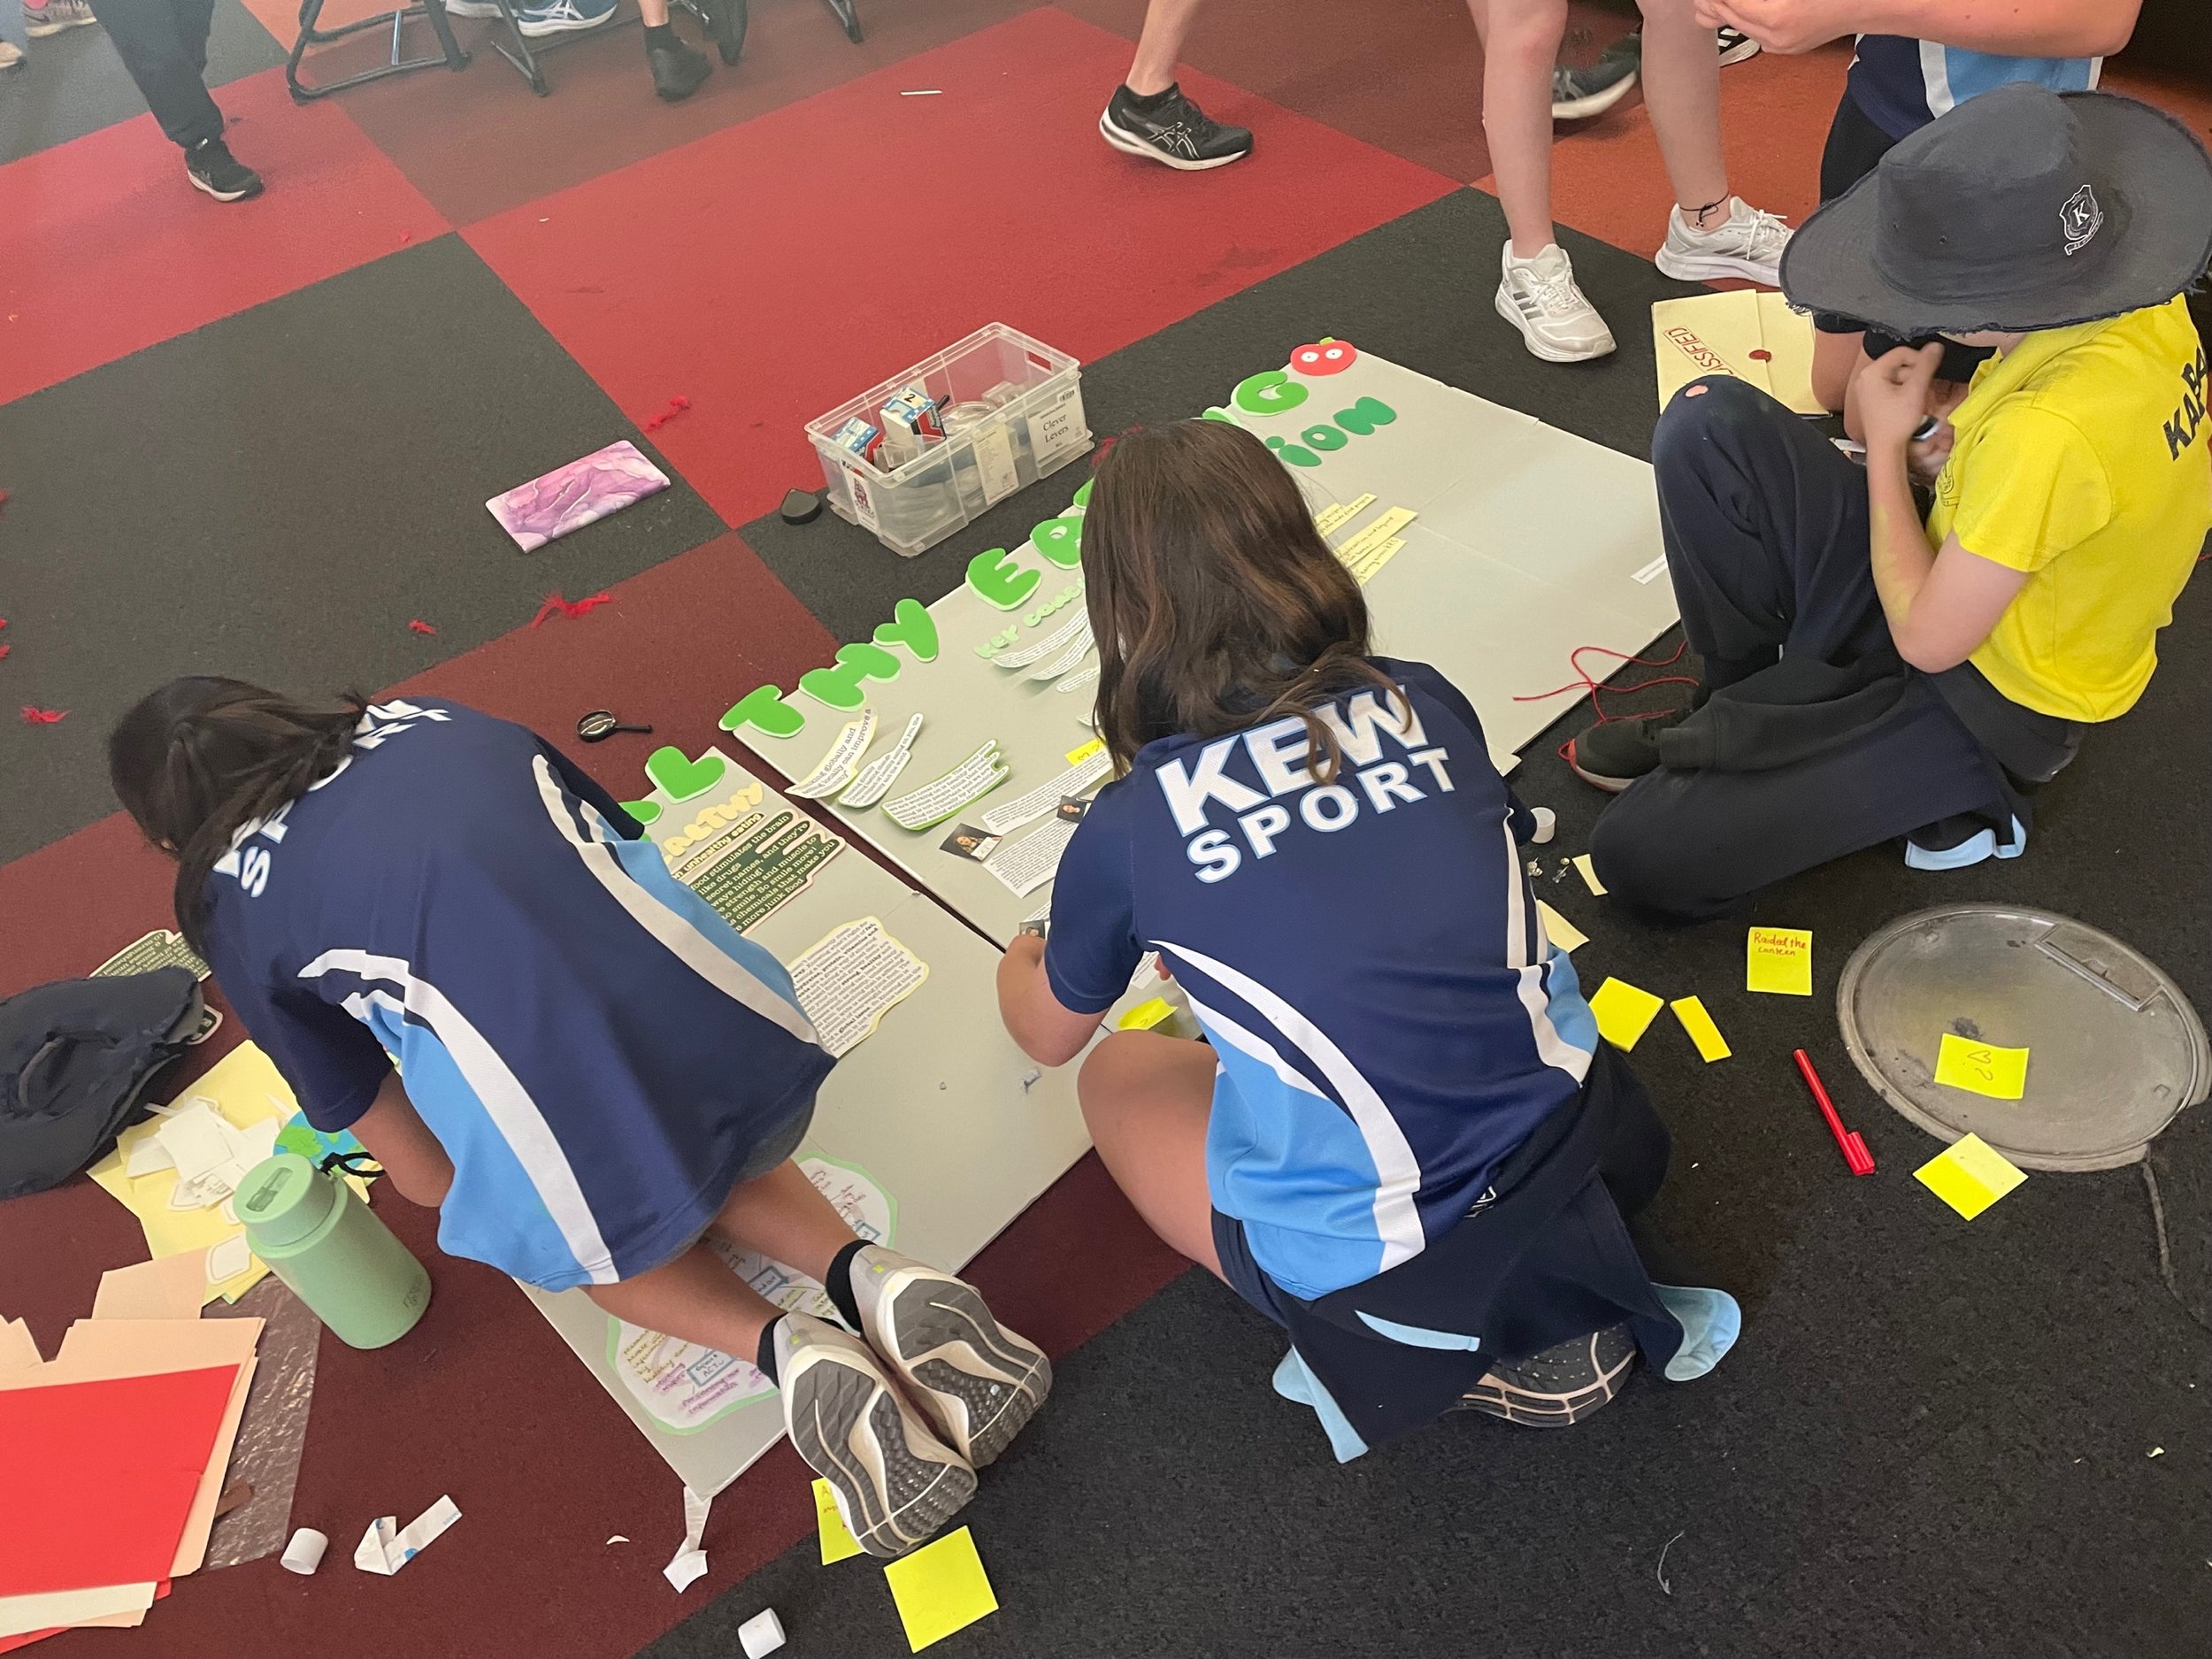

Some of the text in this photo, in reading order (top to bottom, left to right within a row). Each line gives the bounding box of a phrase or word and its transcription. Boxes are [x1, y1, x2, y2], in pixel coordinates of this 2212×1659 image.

[2072, 201, 2090, 227] K
[1665, 325, 1736, 379] ASSIFIED
[903, 393, 917, 403] 2
[1042, 414, 1067, 432] Clever
[1044, 425, 1070, 443] Levers
[1156, 685, 1429, 838] KEW
[682, 834, 732, 872] unhealthy
[730, 812, 762, 837] eating
[1186, 746, 1455, 884] SPORT
[705, 879, 733, 902] secret
[761, 843, 779, 859] and
[777, 821, 809, 848] they're
[709, 841, 753, 877] stimulates
[750, 830, 767, 844] the
[764, 814, 789, 834] brain
[724, 835, 817, 909] strength and muscle to
[698, 861, 742, 895] like drugs
[710, 866, 764, 909] ways hiding!
[731, 891, 758, 913] smile.
[769, 864, 793, 885] smile
[791, 845, 817, 868] more!
[735, 840, 835, 921] chemicals that make you
[741, 876, 803, 926] more junk food
[1790, 937, 1807, 949] the
